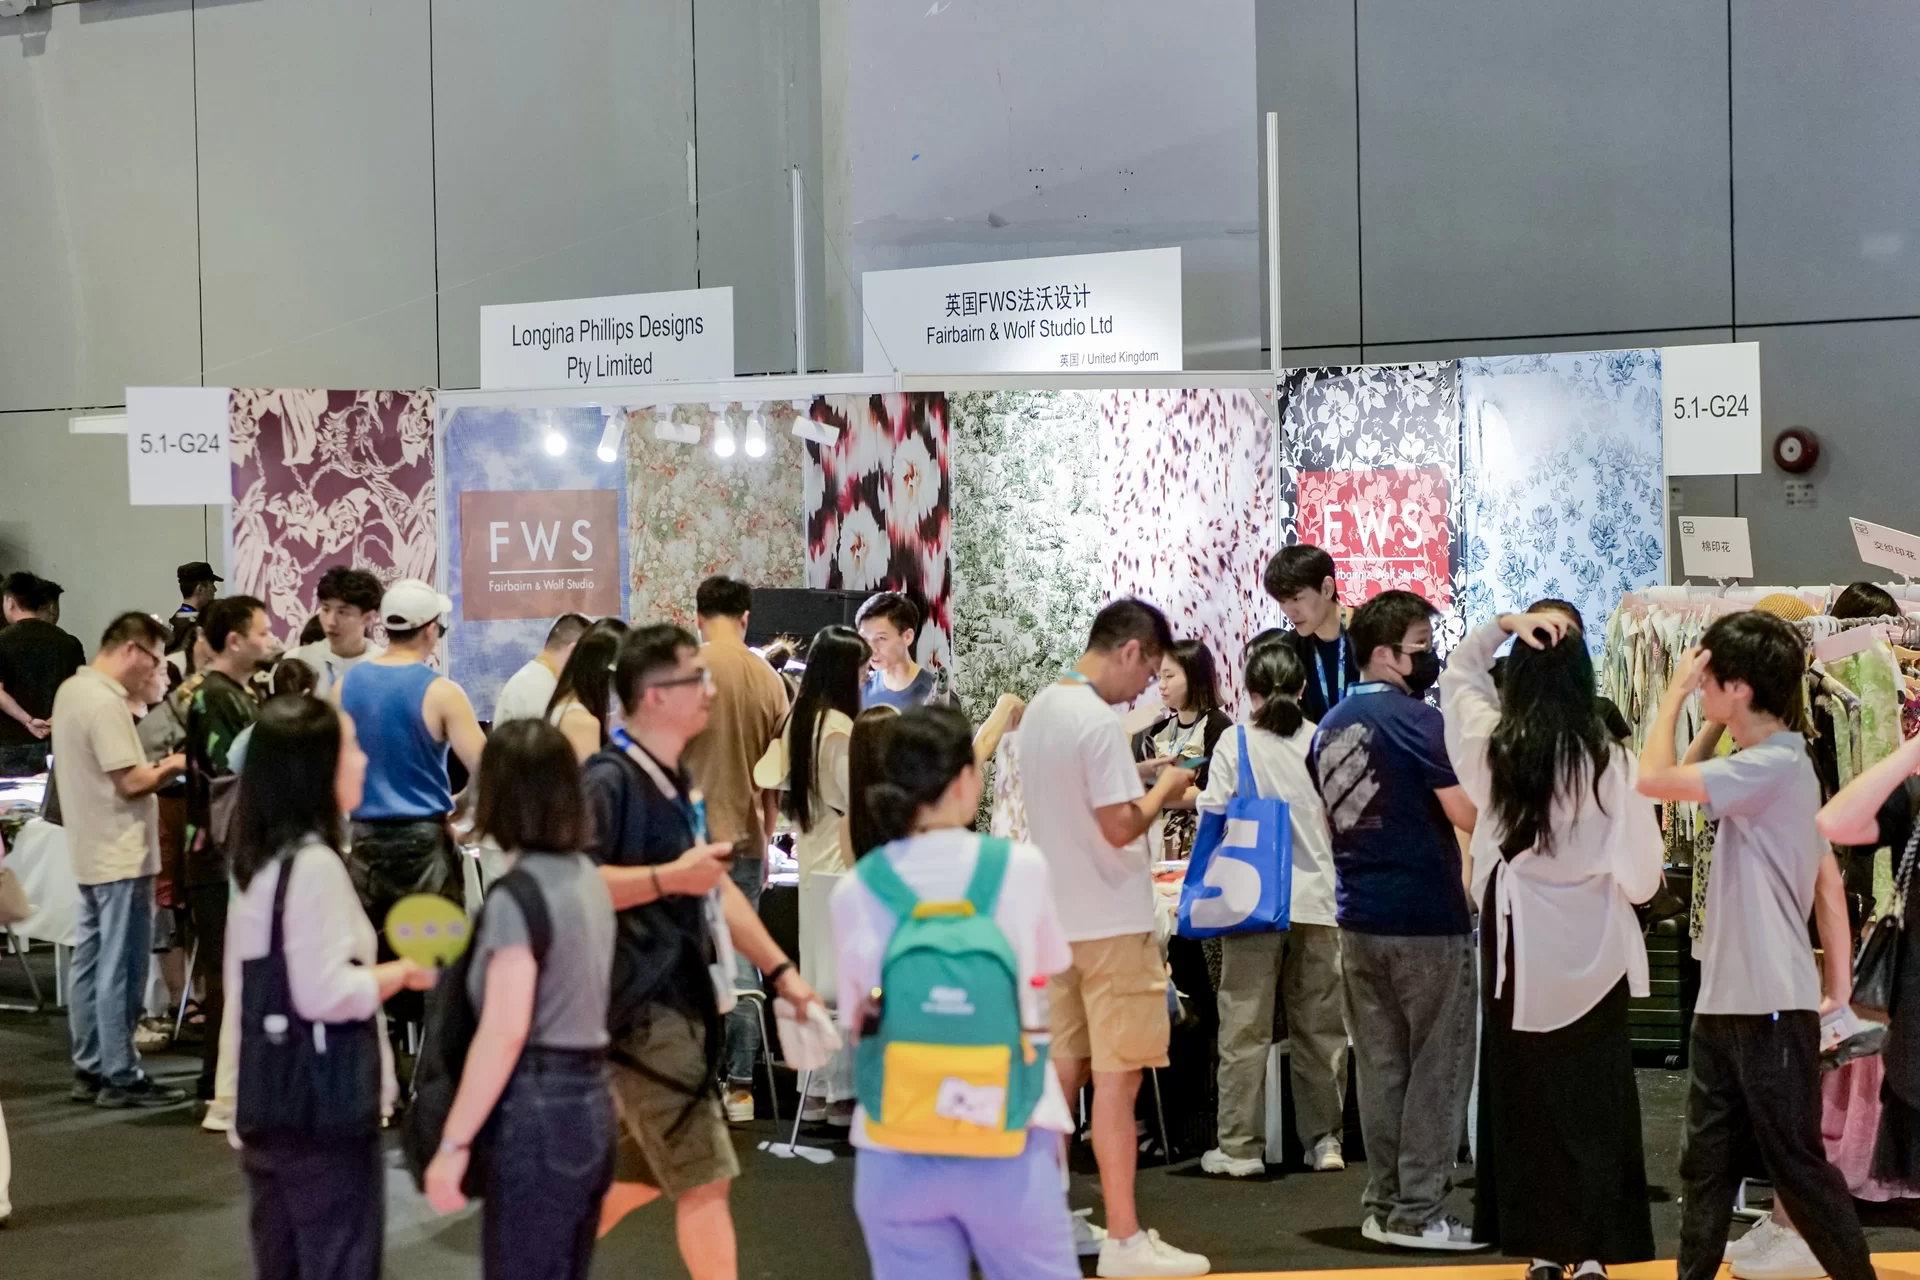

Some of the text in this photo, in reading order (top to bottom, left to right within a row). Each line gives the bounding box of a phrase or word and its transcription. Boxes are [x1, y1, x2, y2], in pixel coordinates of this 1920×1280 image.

[945, 283, 1091, 318] 英国FWS法沃设计
[512, 313, 704, 351] Longina Phillips Designs
[926, 315, 1113, 345] Fairbairn & Wolf Studio Ltd
[567, 352, 653, 384] Pty Limited
[1059, 353, 1079, 367] 英国
[1087, 352, 1117, 365] United
[1118, 350, 1159, 366] Kingdom
[1673, 394, 1749, 419] 5.1-G24
[140, 433, 221, 453] 5.1-G24
[1322, 502, 1424, 550] FWS
[489, 519, 594, 563] FWS
[1701, 540, 1731, 553] 棉印花
[1873, 540, 1917, 561] 交织印花
[489, 578, 595, 592] Fairbairn & Wolf Studio
[1335, 568, 1365, 580] irbairn
[1375, 568, 1396, 580] Wolf
[1397, 567, 1425, 580] Studio
